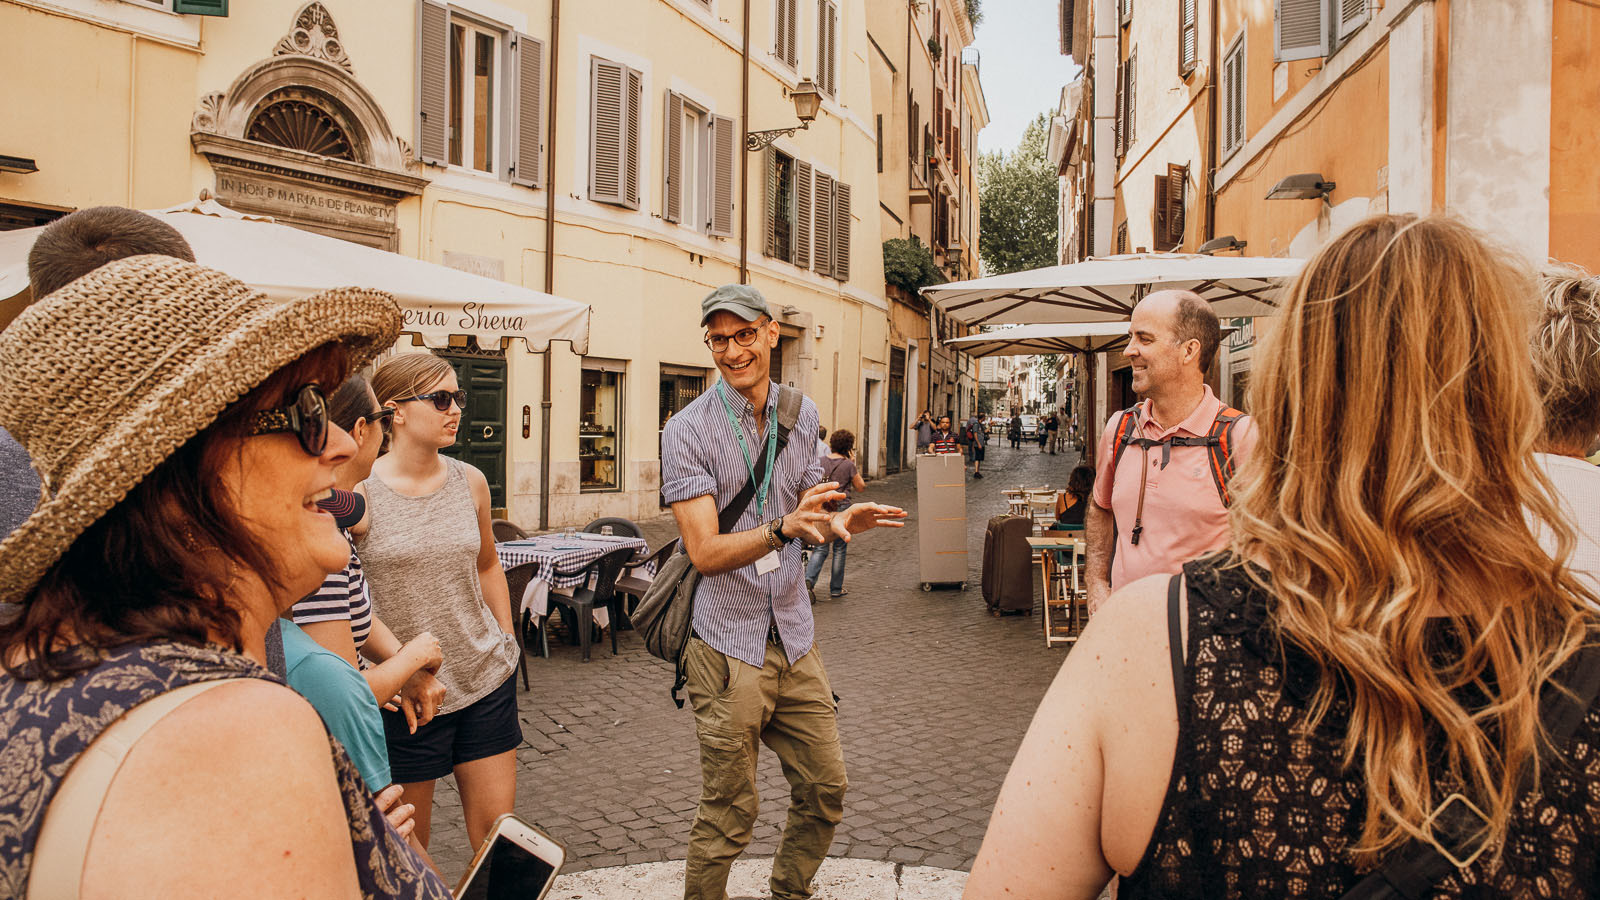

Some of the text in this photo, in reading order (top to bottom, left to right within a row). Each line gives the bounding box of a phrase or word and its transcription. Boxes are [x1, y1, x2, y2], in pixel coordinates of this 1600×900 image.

[221, 178, 234, 191] IN
[278, 189, 324, 207] MARIAE
[327, 198, 342, 210] DE
[402, 302, 528, 332] eria Sheva
